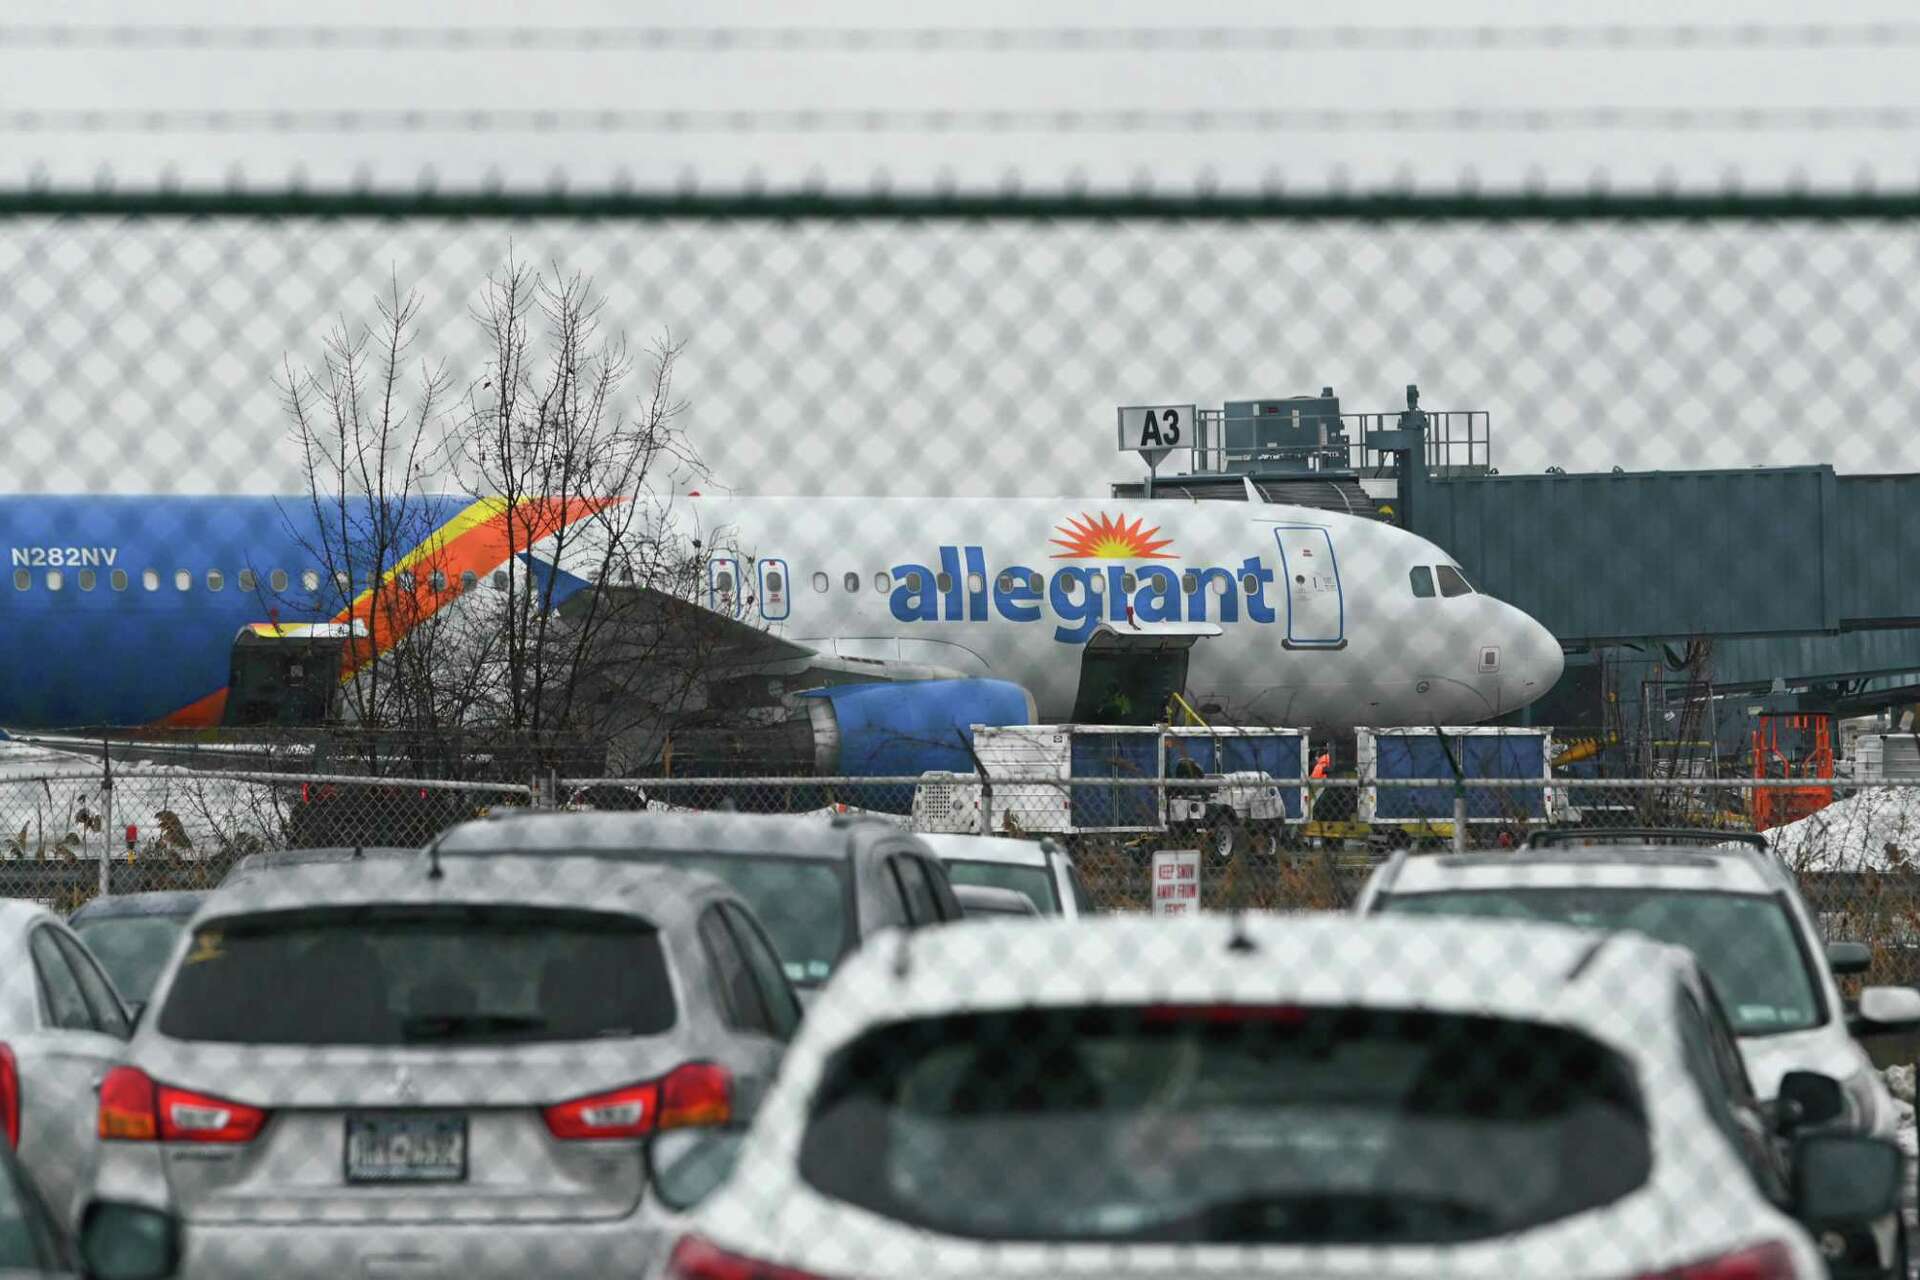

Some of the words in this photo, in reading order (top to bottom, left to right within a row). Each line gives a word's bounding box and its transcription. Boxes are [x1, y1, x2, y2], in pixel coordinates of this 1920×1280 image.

[1141, 409, 1180, 446] A3
[11, 547, 117, 566] N282NV
[889, 546, 1275, 644] allegiant
[1158, 864, 1175, 880] KEEP
